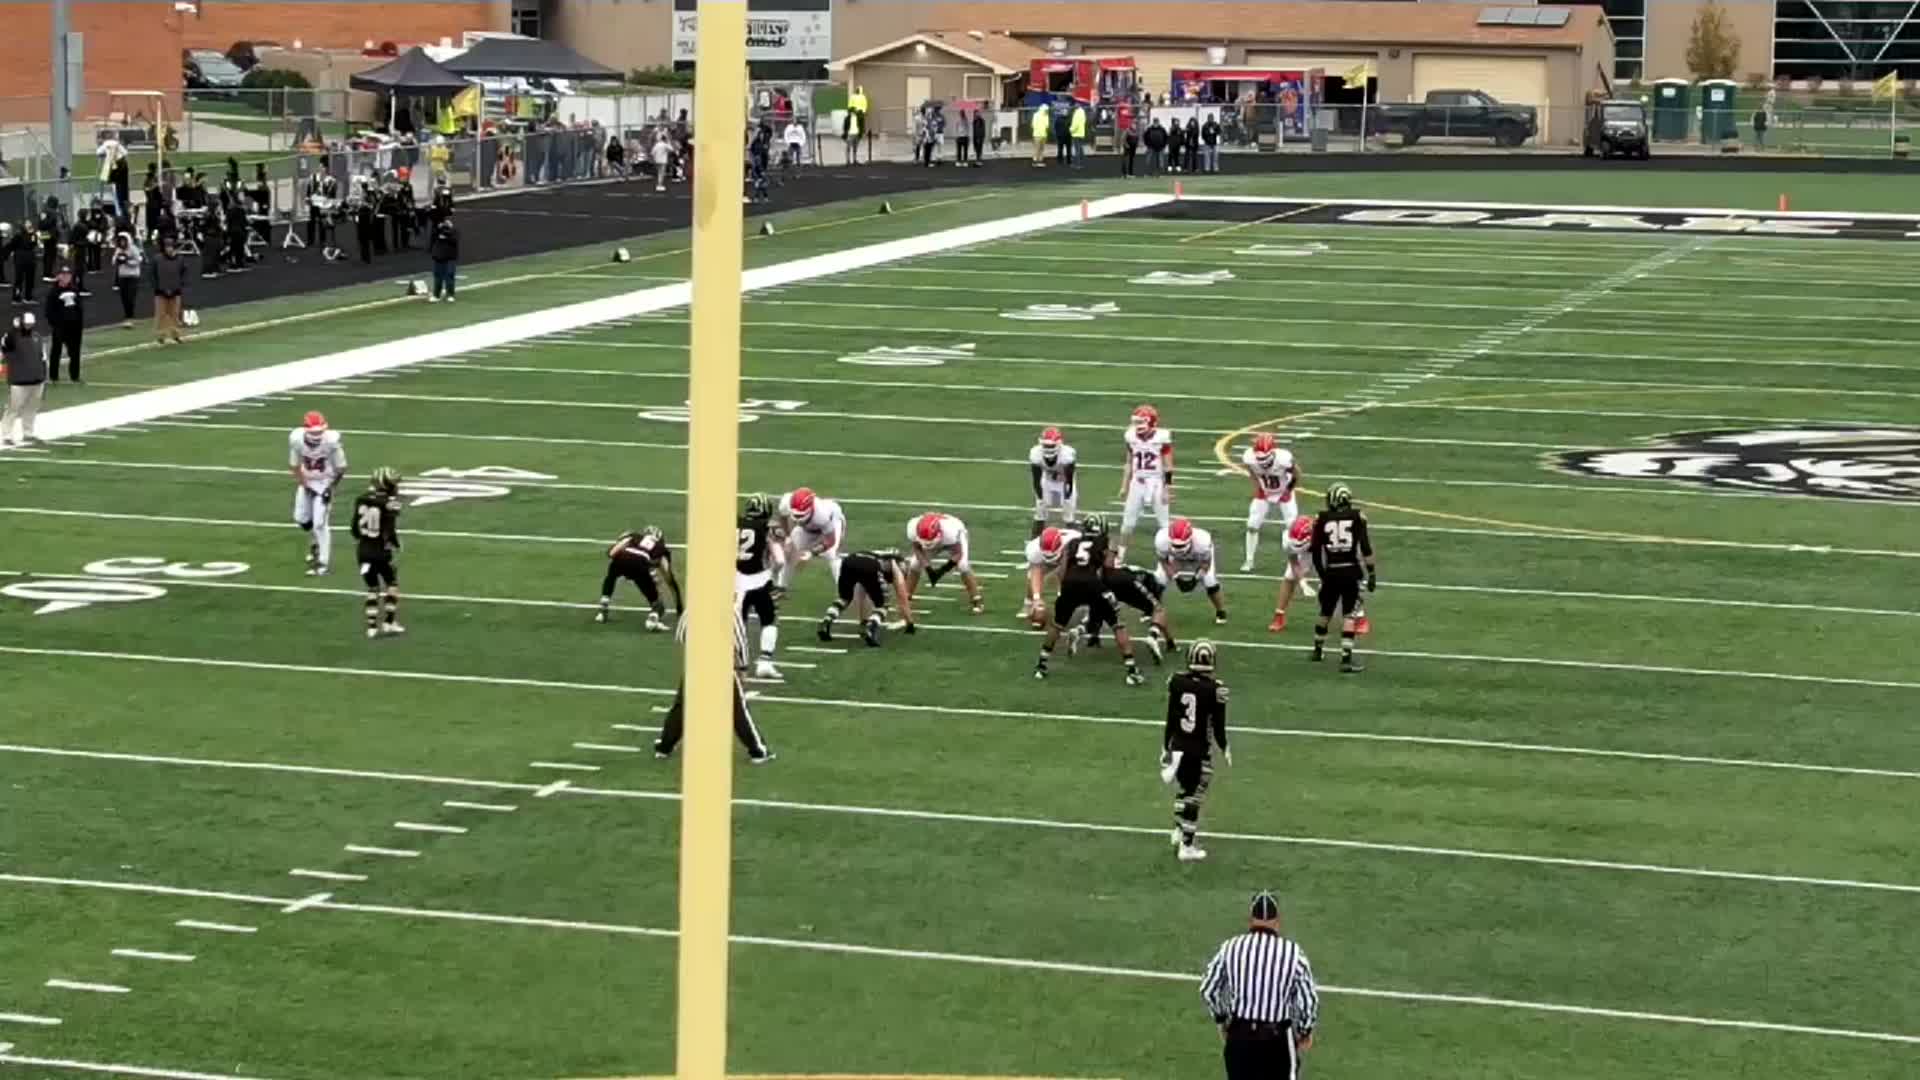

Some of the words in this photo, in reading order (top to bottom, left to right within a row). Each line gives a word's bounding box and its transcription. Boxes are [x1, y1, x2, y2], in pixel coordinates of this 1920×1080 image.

[1135, 450, 1157, 470] 12
[358, 504, 381, 538] 20
[1324, 519, 1354, 551] 35
[1075, 541, 1094, 566] 5
[0, 557, 251, 602] 30
[1180, 692, 1197, 733] 3
